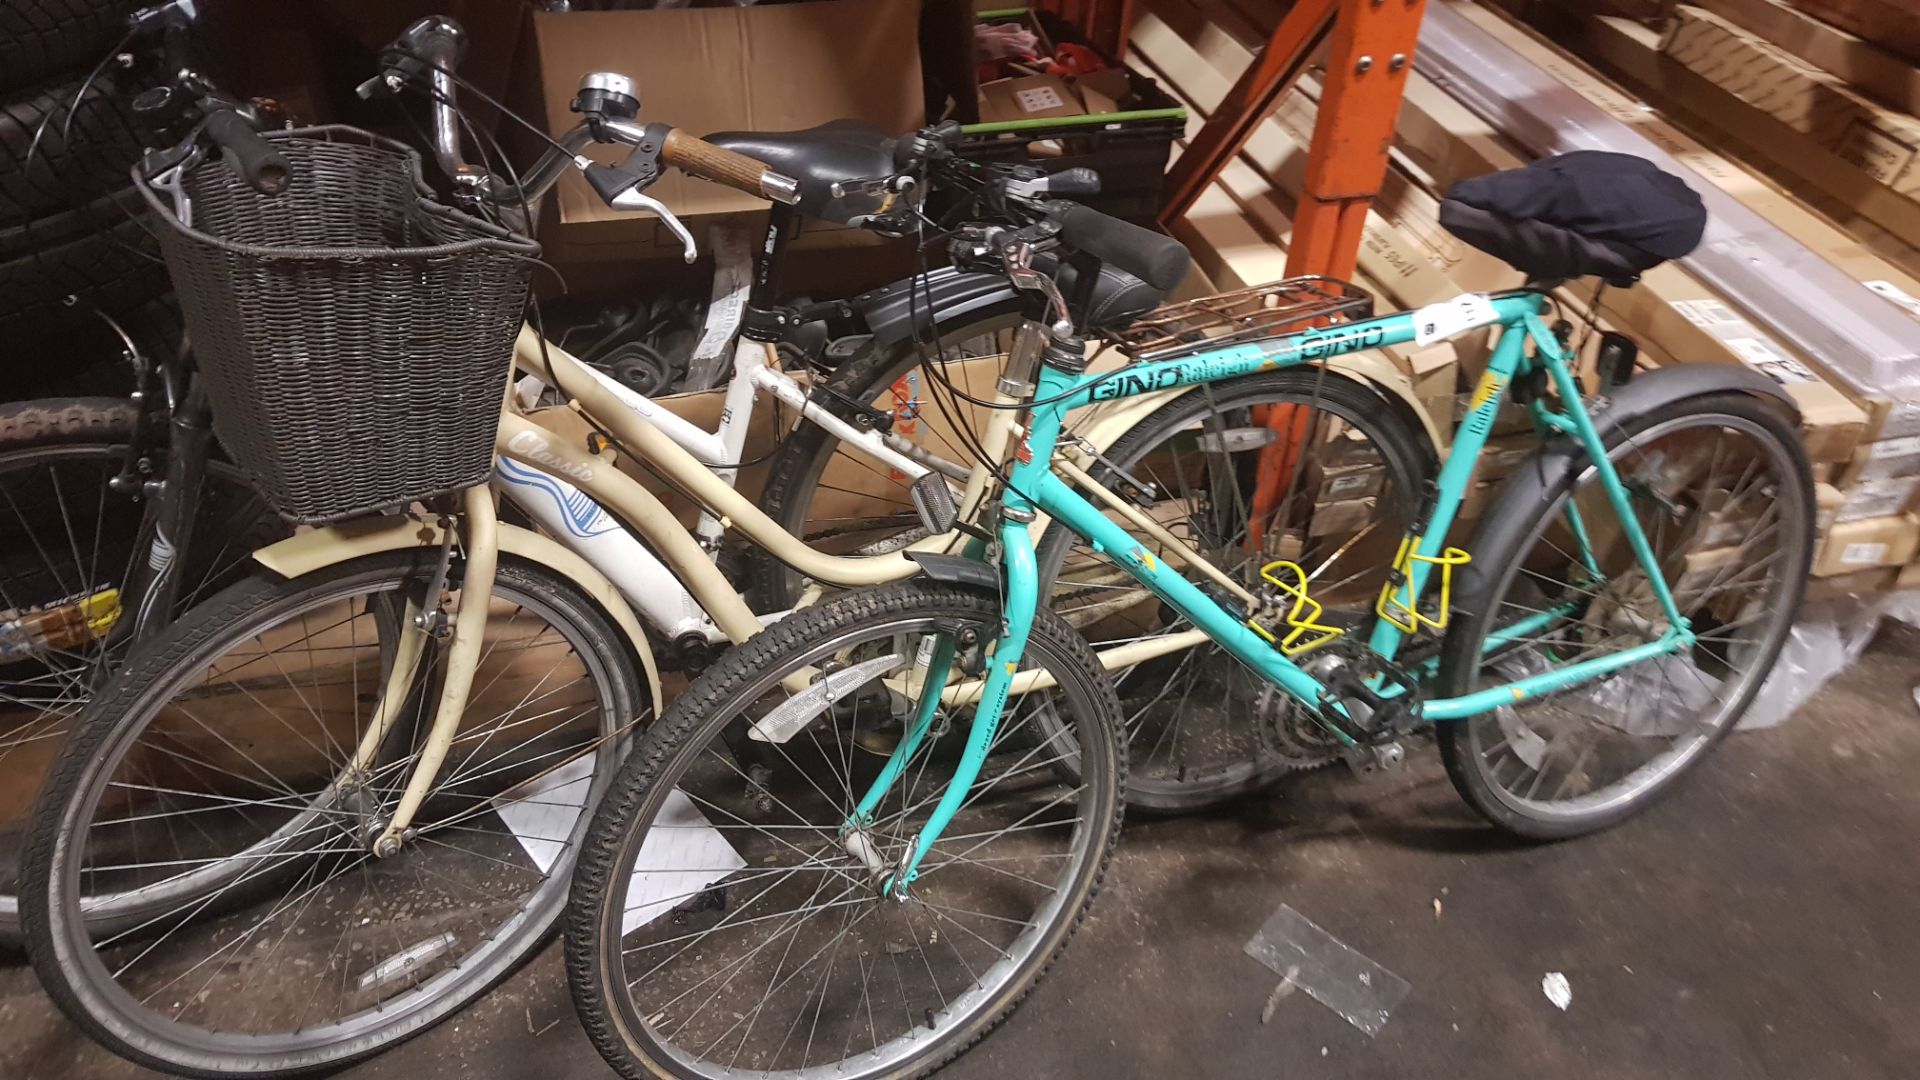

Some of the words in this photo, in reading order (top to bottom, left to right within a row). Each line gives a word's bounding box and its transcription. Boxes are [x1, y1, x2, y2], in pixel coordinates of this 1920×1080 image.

[1299, 326, 1384, 361] GINO
[1087, 363, 1182, 403] GINO
[507, 430, 593, 482] Classic
